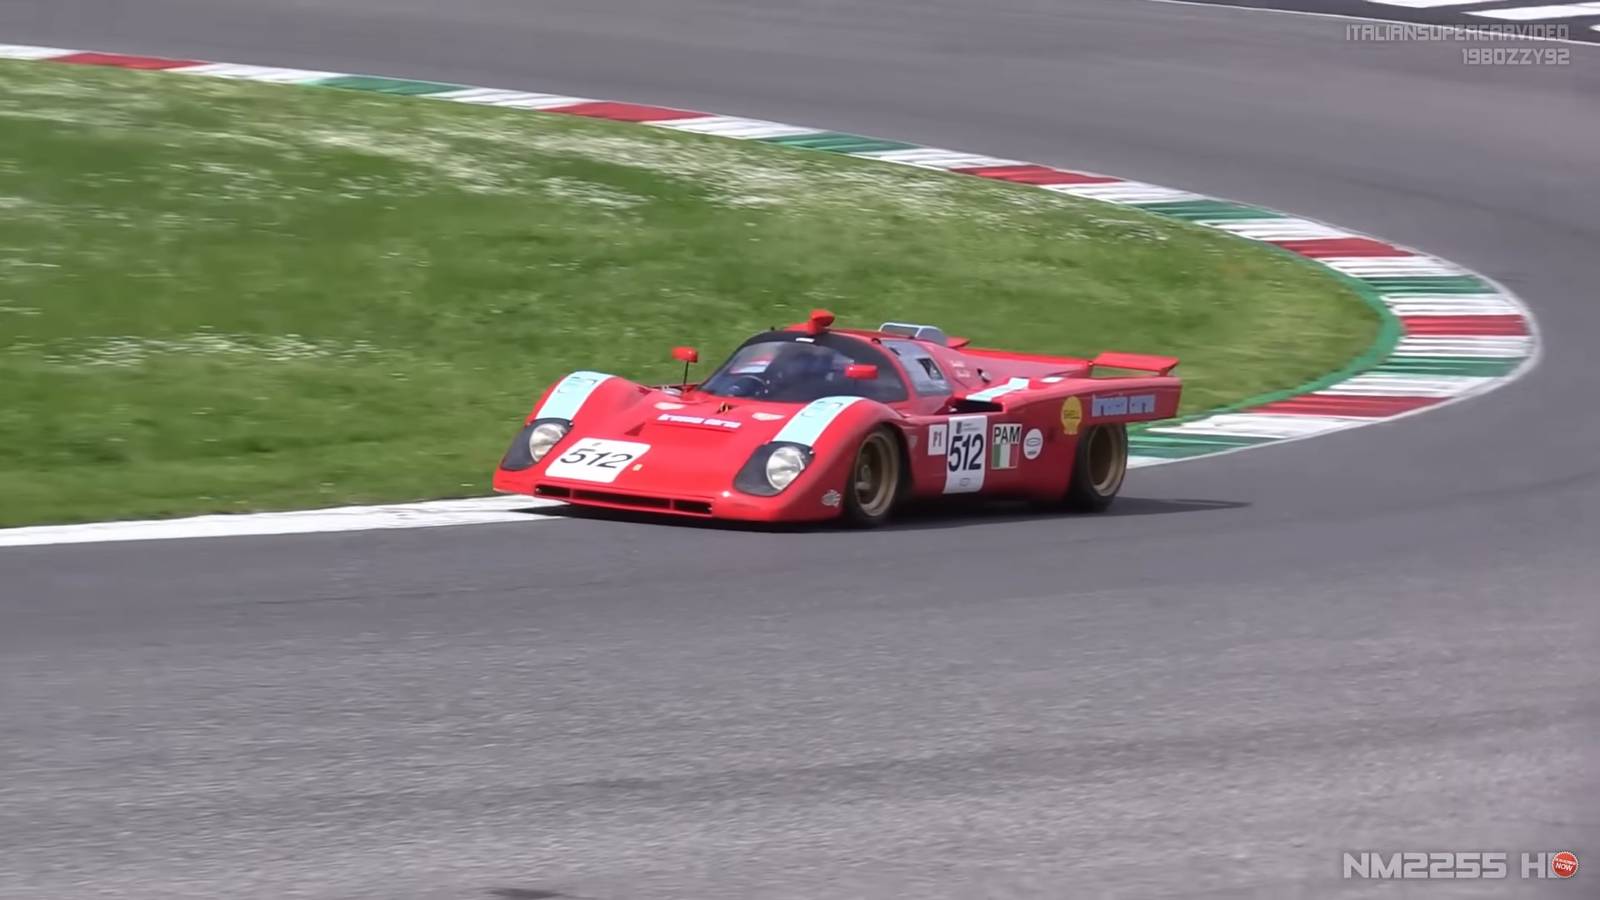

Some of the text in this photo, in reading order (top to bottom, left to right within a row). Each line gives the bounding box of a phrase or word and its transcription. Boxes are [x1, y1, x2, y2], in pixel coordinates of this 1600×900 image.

[993, 425, 1020, 444] PAM
[560, 448, 633, 468] 512
[948, 433, 984, 472] 512
